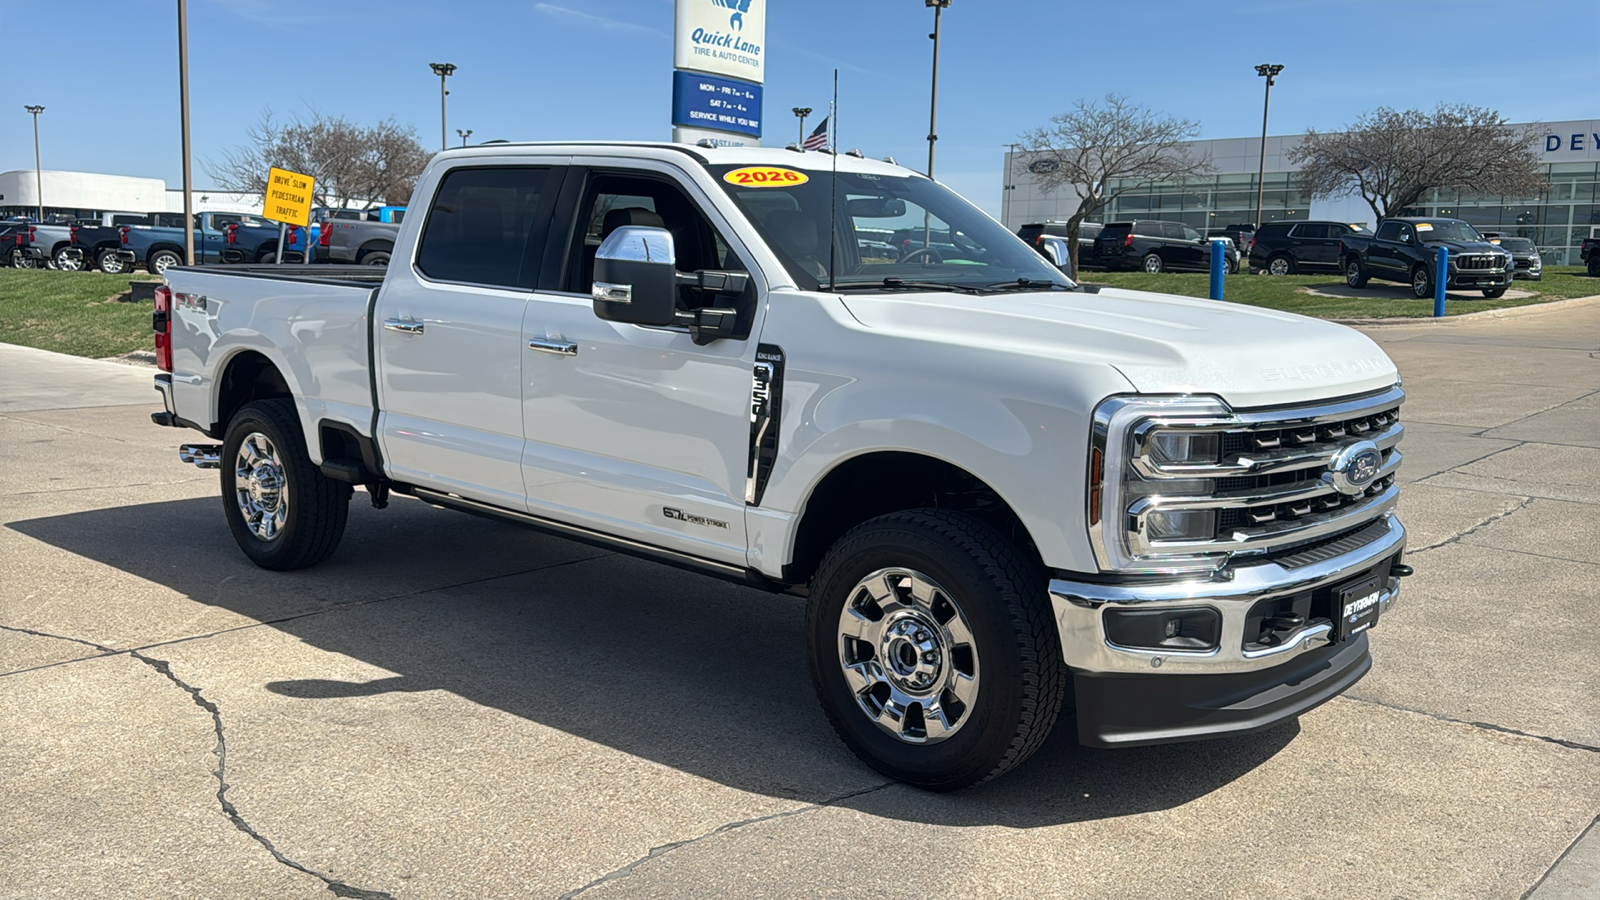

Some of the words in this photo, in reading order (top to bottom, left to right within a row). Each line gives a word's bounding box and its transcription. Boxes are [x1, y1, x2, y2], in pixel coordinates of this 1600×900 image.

[691, 27, 733, 48] Quick
[733, 36, 761, 56] Lane
[693, 46, 711, 57] TIRE
[712, 50, 717, 58] &
[719, 51, 737, 62] AUTO
[737, 55, 760, 67] CENTER
[700, 83, 715, 92] MON
[722, 86, 731, 95] FRI
[710, 99, 721, 108] SAT
[690, 110, 717, 121] SERVICE
[719, 114, 736, 124] WHILE
[737, 117, 748, 126] YOU
[274, 175, 291, 187] DRIVE
[292, 179, 307, 190] SLOW
[736, 170, 799, 183] 2026
[271, 190, 305, 204] PEDESTRIAN
[276, 206, 298, 218] TRAFFIC
[176, 292, 207, 311] FX4
[687, 514, 705, 525] POWER
[706, 519, 728, 529] STROKE
[1343, 590, 1380, 617] DEYARMAN
